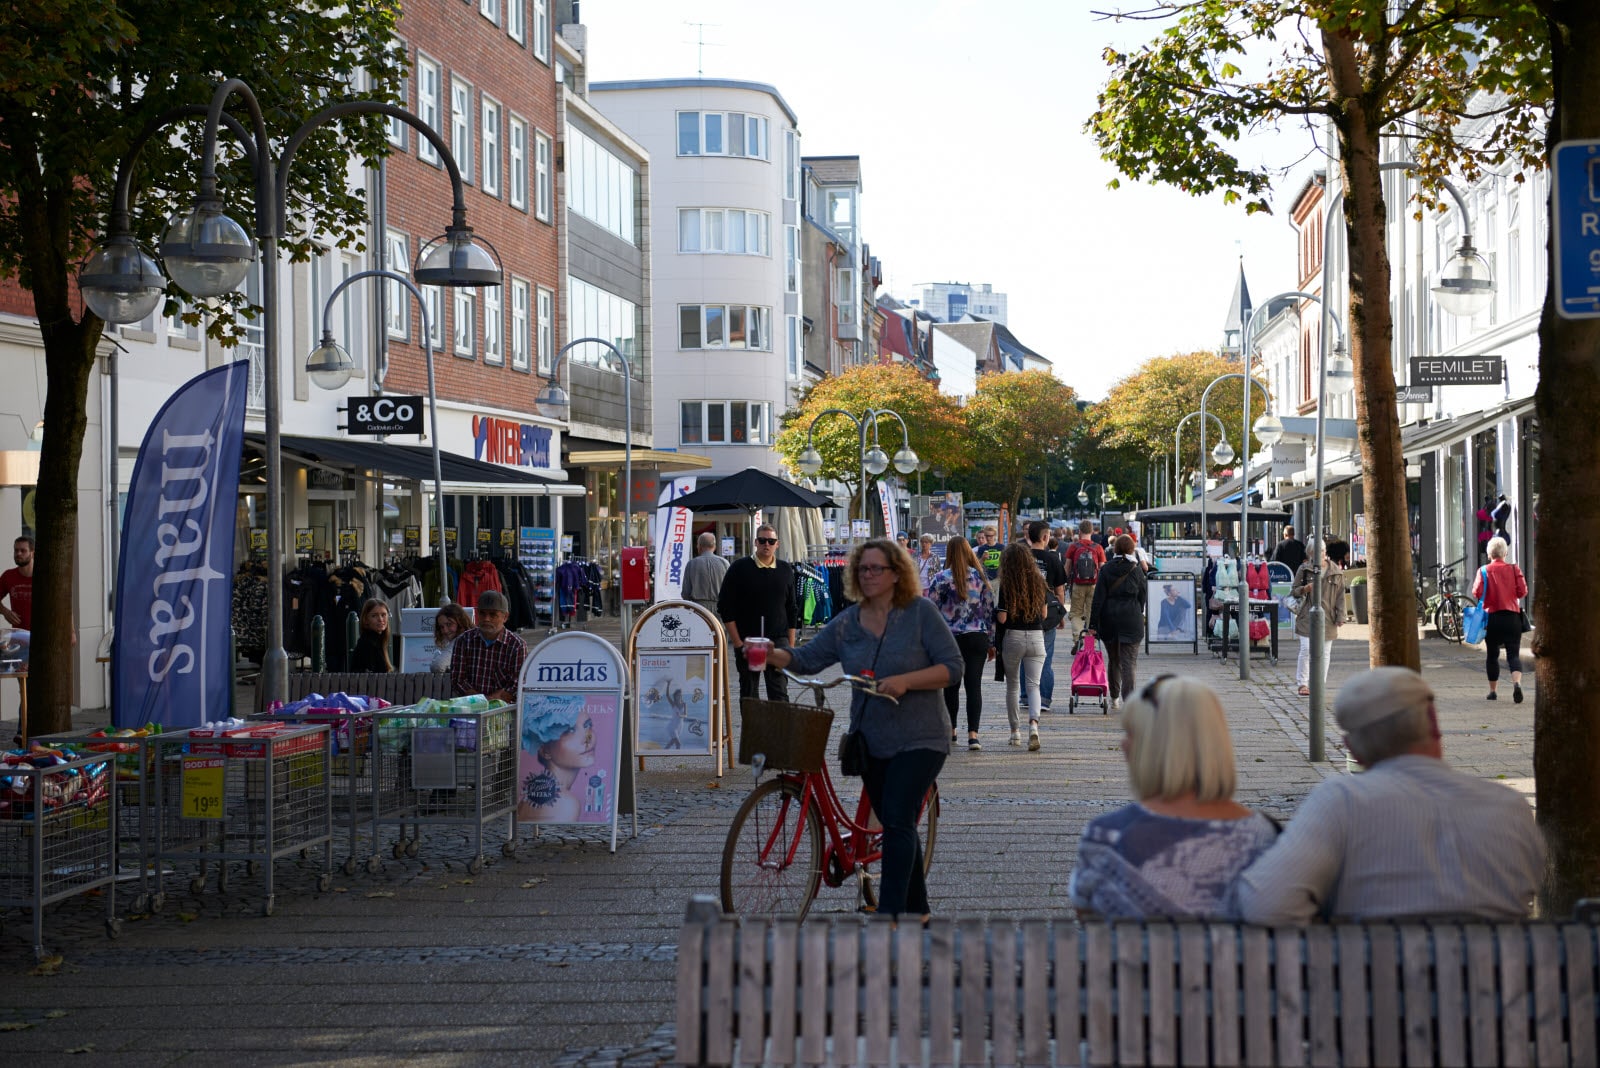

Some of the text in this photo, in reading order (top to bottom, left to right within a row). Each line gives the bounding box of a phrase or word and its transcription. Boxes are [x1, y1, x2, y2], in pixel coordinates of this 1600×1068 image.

[1418, 360, 1496, 374] FEMILET
[356, 399, 414, 422] &Co
[486, 416, 553, 469] INTERSPORT
[147, 428, 226, 683] matas
[669, 505, 687, 586] NTERSPORT
[537, 659, 608, 682] matas
[184, 760, 206, 769] GODT
